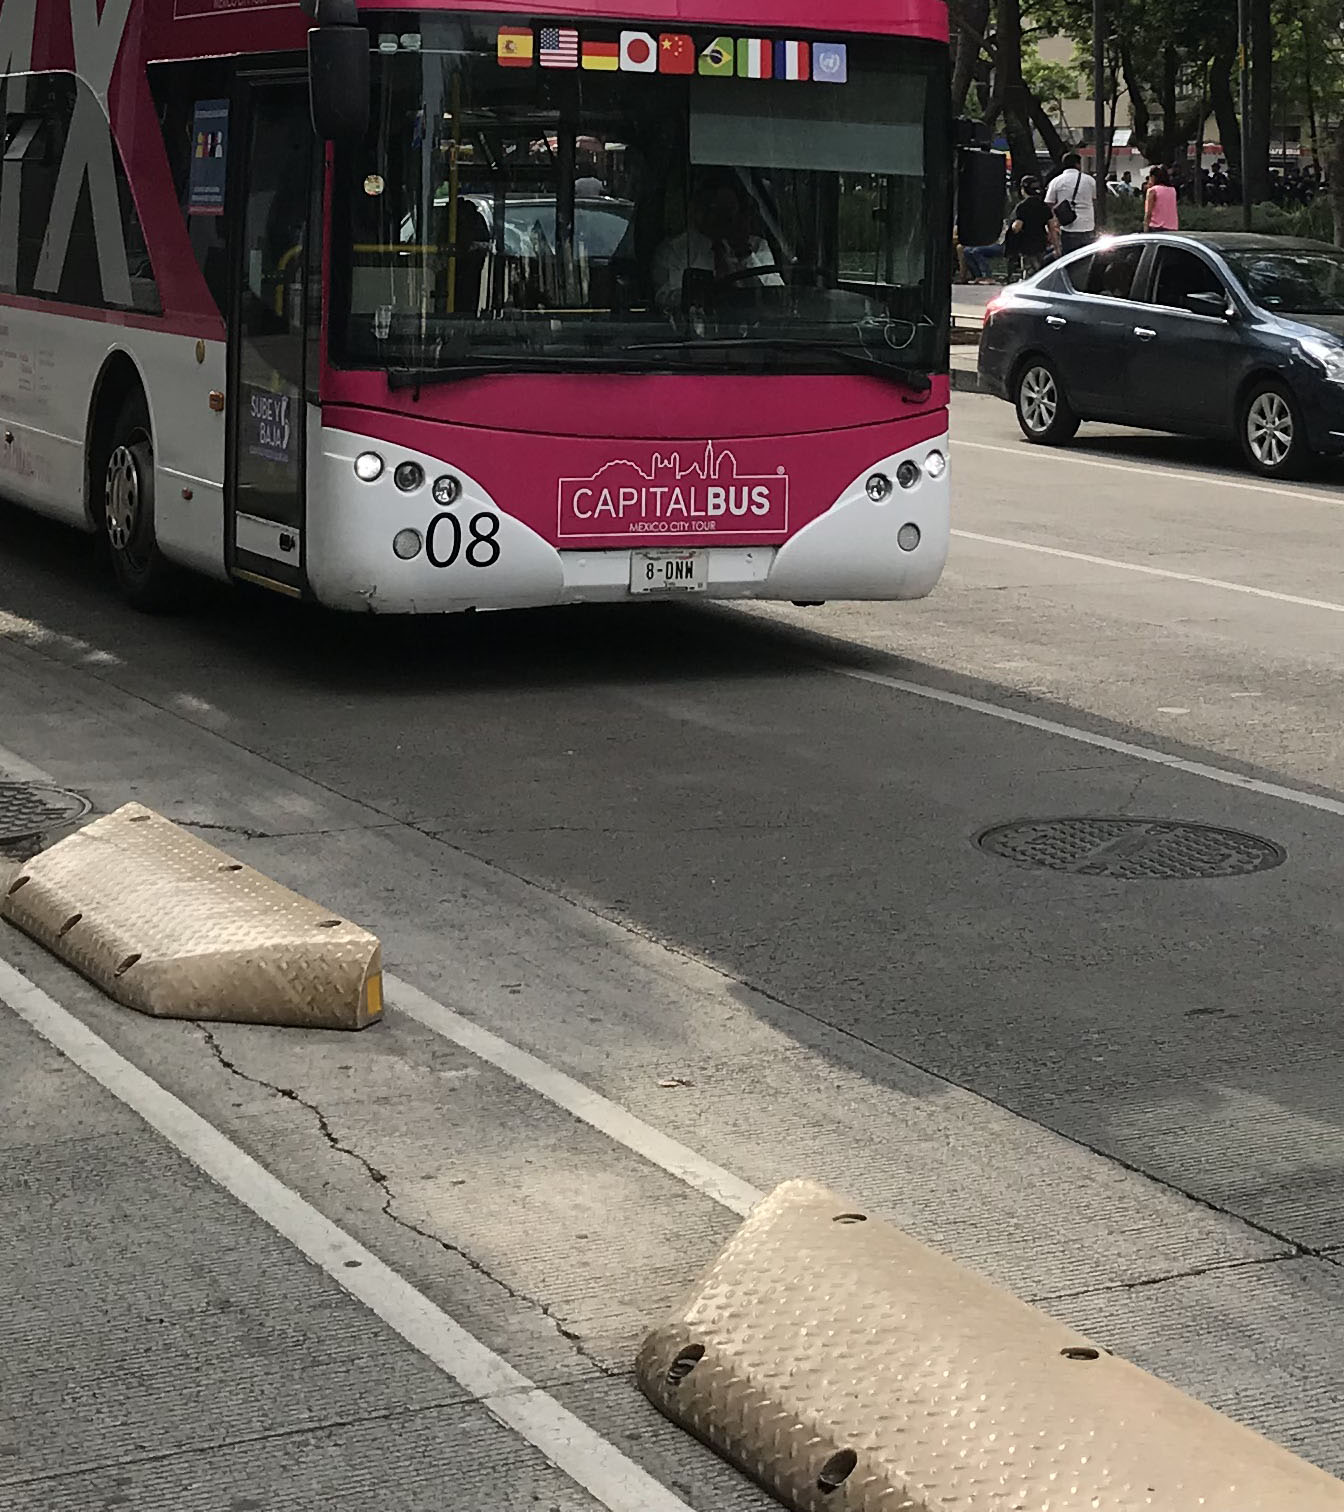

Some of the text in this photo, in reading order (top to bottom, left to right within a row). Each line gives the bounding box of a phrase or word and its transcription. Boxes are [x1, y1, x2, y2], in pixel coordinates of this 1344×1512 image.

[250, 395, 281, 422] SUBE Y
[260, 422, 282, 448] BAJA
[572, 486, 771, 519] CAPITALBUS
[425, 511, 501, 568] 08
[629, 520, 716, 532] MEXICO CITY TOUR
